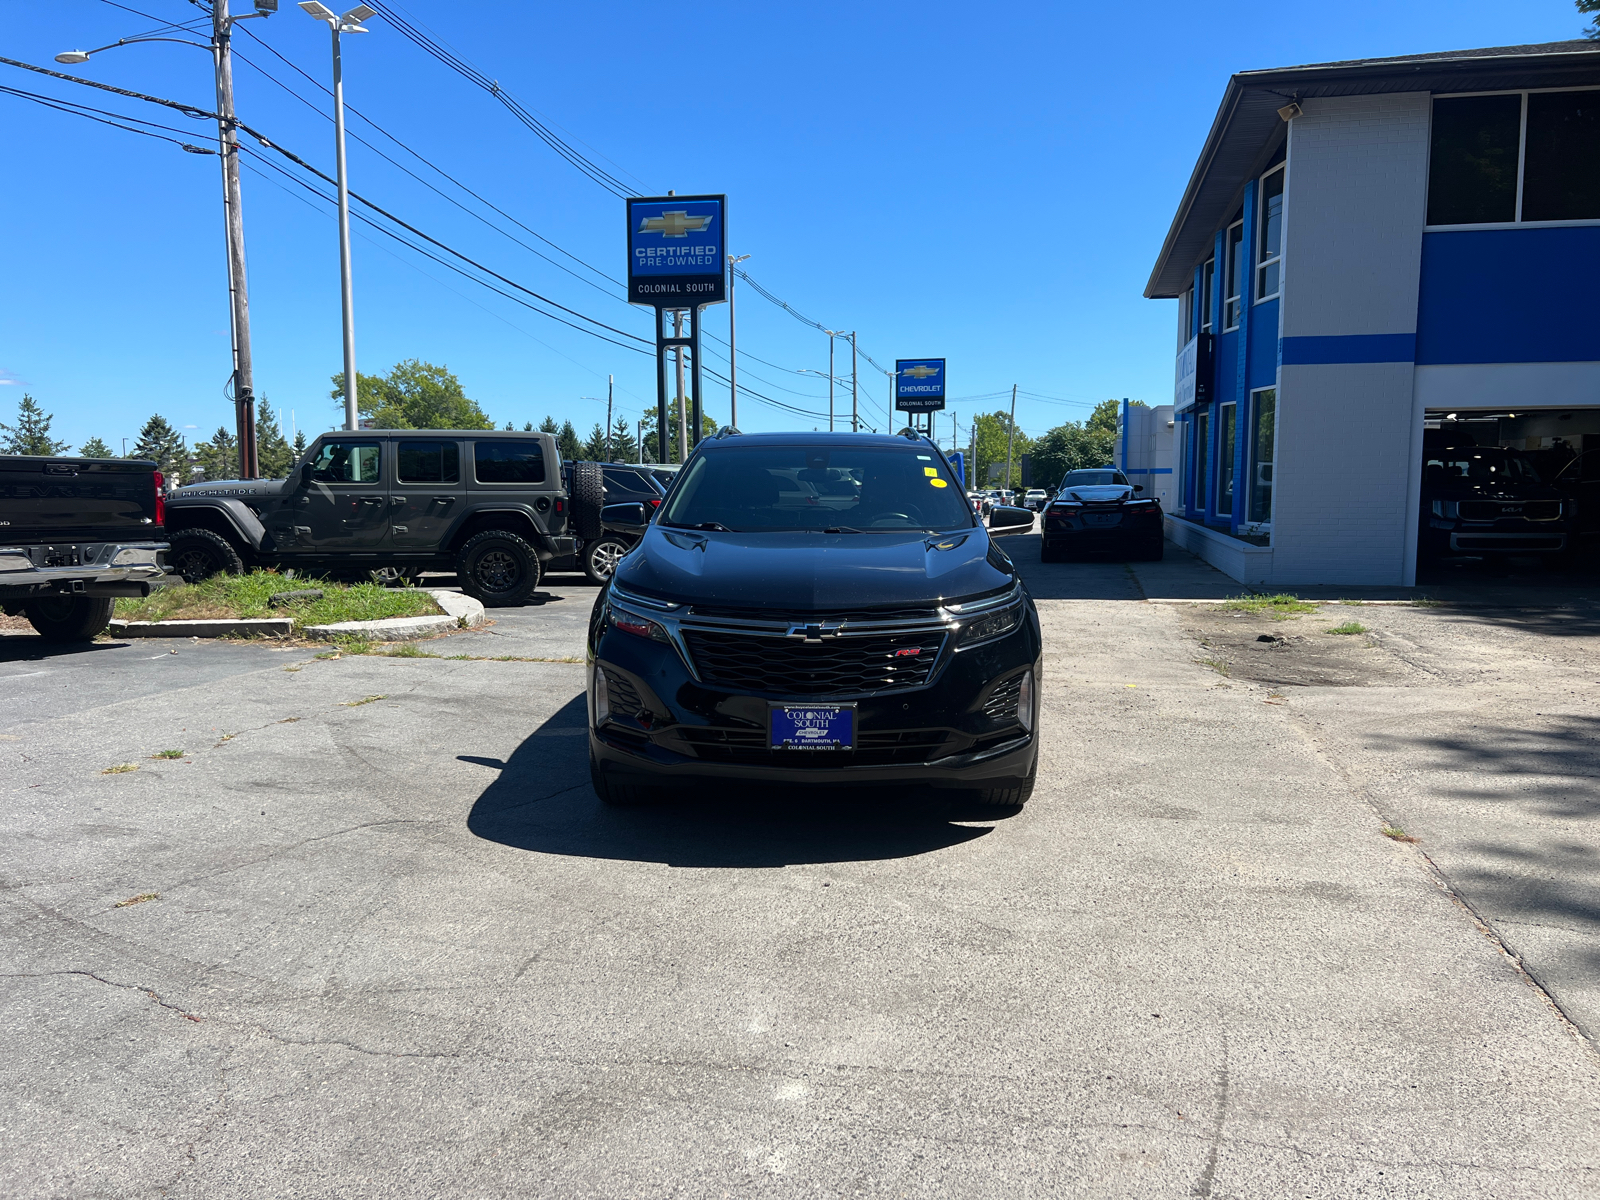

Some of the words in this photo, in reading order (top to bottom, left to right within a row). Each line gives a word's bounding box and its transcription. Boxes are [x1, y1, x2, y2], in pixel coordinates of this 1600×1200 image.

[635, 246, 716, 257] CERTIFIED
[640, 256, 713, 266] PRE-OWNED
[638, 284, 681, 293] COLONIAL
[686, 283, 715, 292] SOUTH
[786, 711, 836, 719] COLONIAL
